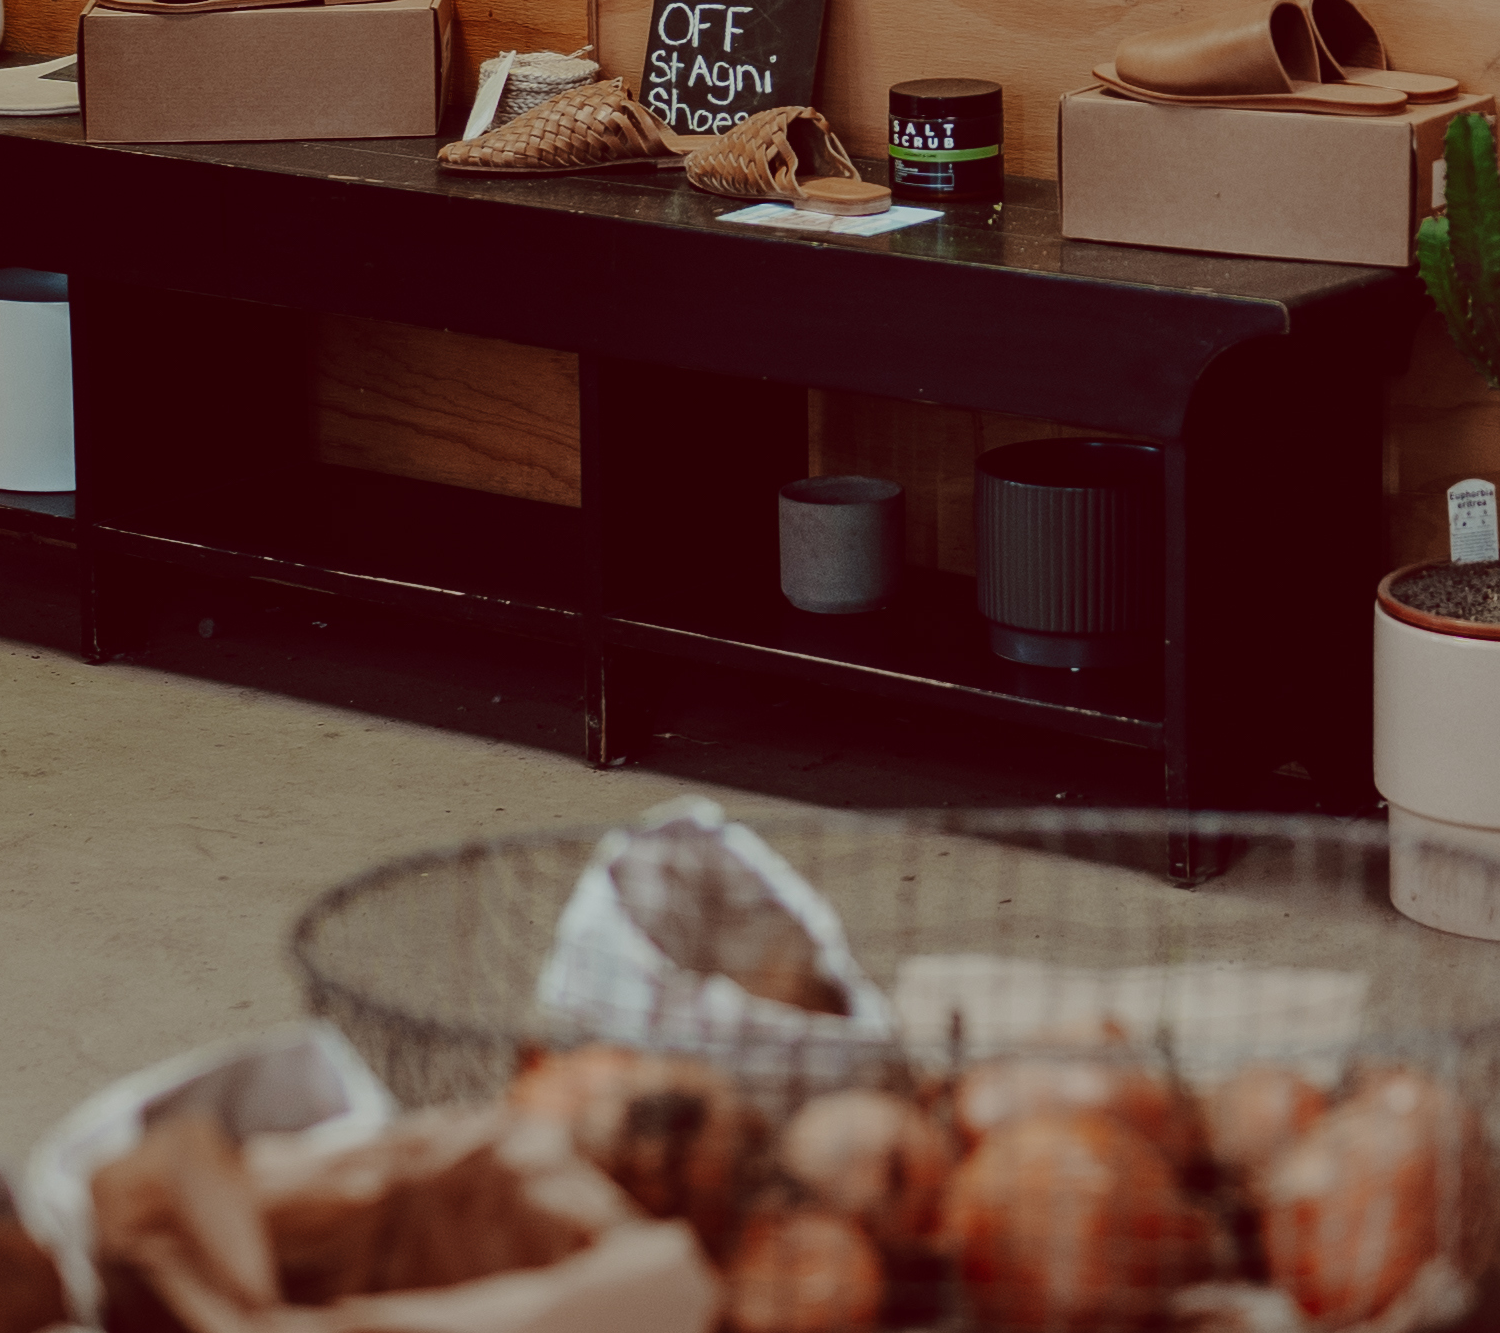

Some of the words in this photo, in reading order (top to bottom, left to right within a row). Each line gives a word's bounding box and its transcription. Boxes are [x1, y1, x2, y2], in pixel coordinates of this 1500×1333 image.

[658, 2, 754, 52] OFF
[649, 49, 685, 83] St
[688, 54, 777, 105] Agni
[893, 120, 955, 136] SALT
[893, 134, 955, 149] SCRUB
